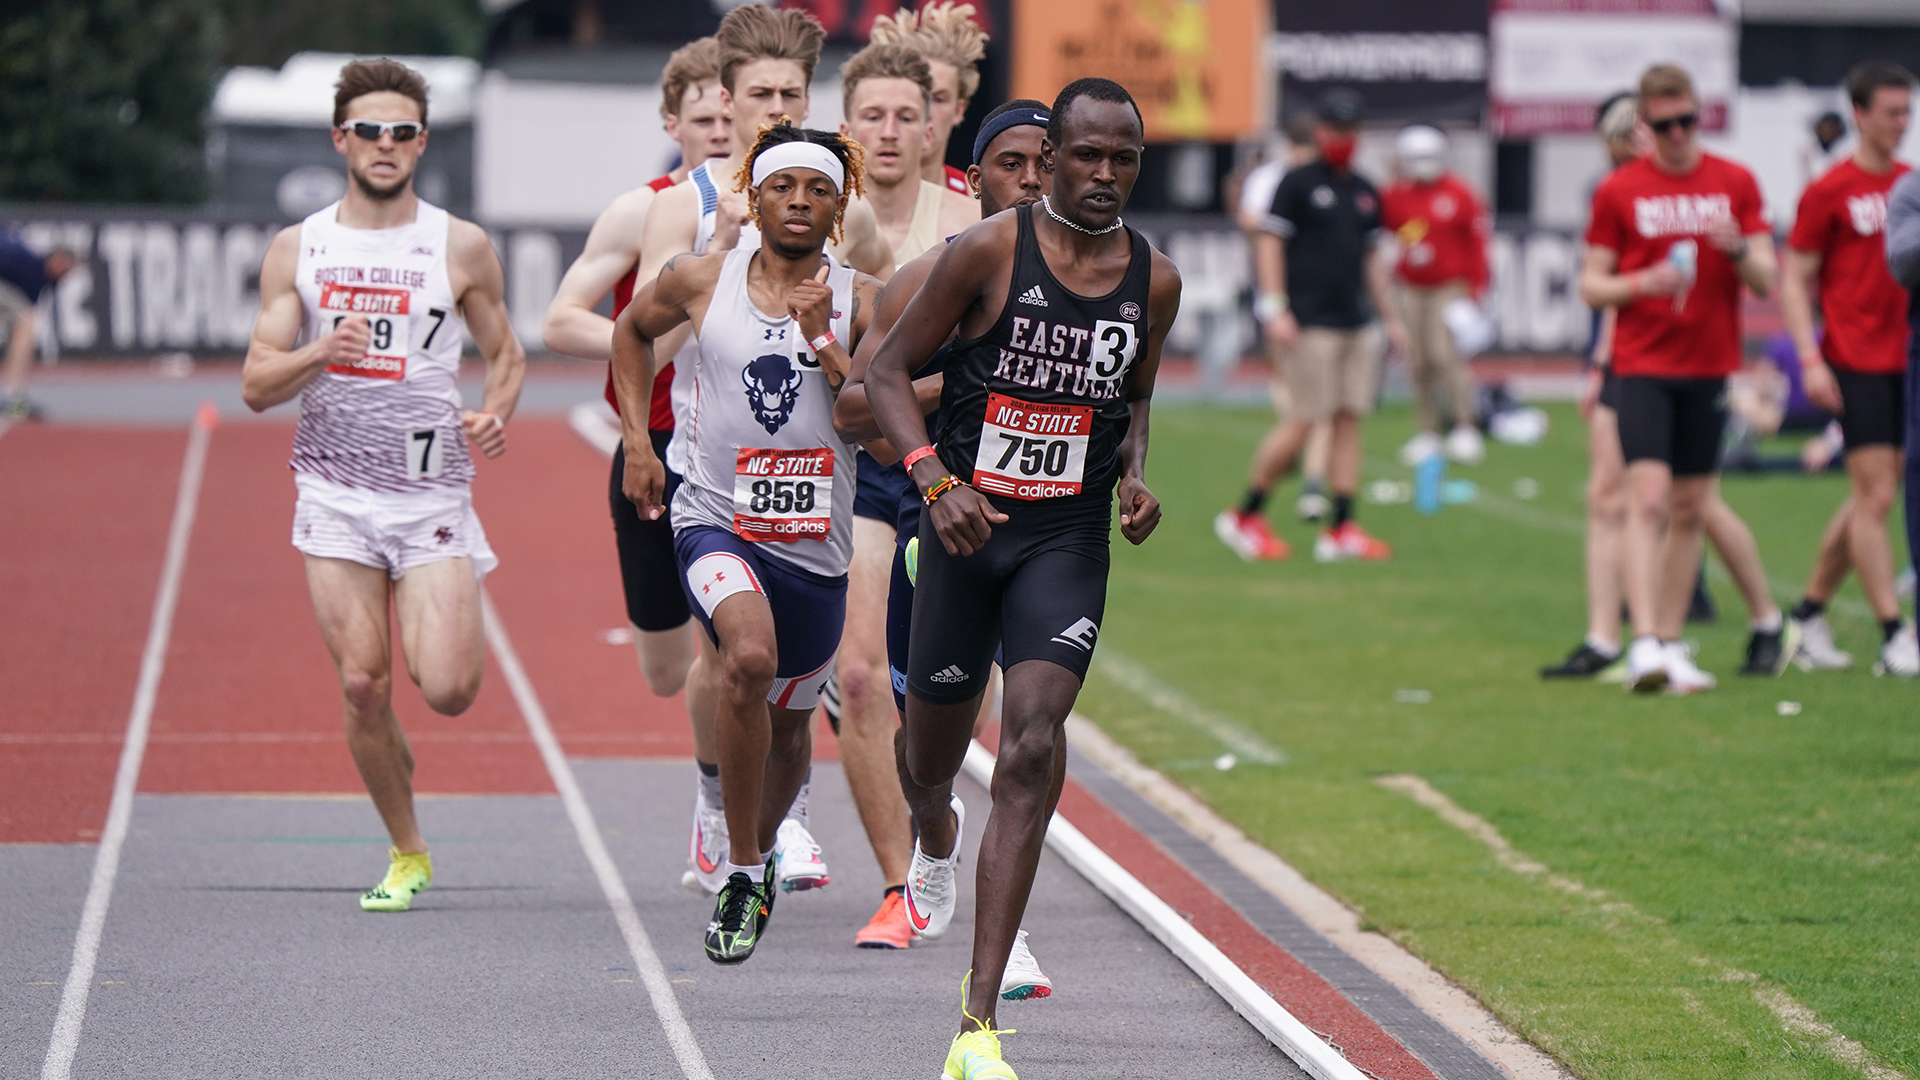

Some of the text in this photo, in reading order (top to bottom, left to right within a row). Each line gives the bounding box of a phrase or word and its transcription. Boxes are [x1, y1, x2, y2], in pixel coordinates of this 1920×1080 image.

[100, 220, 284, 348] TRAC
[315, 266, 426, 288] BOSTON COLLEGE
[327, 291, 402, 313] NC STATE
[1018, 295, 1048, 308] adidas
[422, 308, 446, 350] 7
[1010, 316, 1139, 366] EAST
[1095, 326, 1127, 377] 3
[1010, 400, 1024, 409] 2021
[1025, 404, 1049, 412] RALEIGH
[995, 406, 1082, 433] NC STATE
[413, 430, 435, 472] 7
[995, 432, 1070, 477] 750
[746, 457, 825, 475] NC STATE
[750, 480, 815, 513] 859
[1018, 483, 1074, 498] adidas
[774, 520, 826, 534] adidas
[930, 673, 969, 683] adidas
